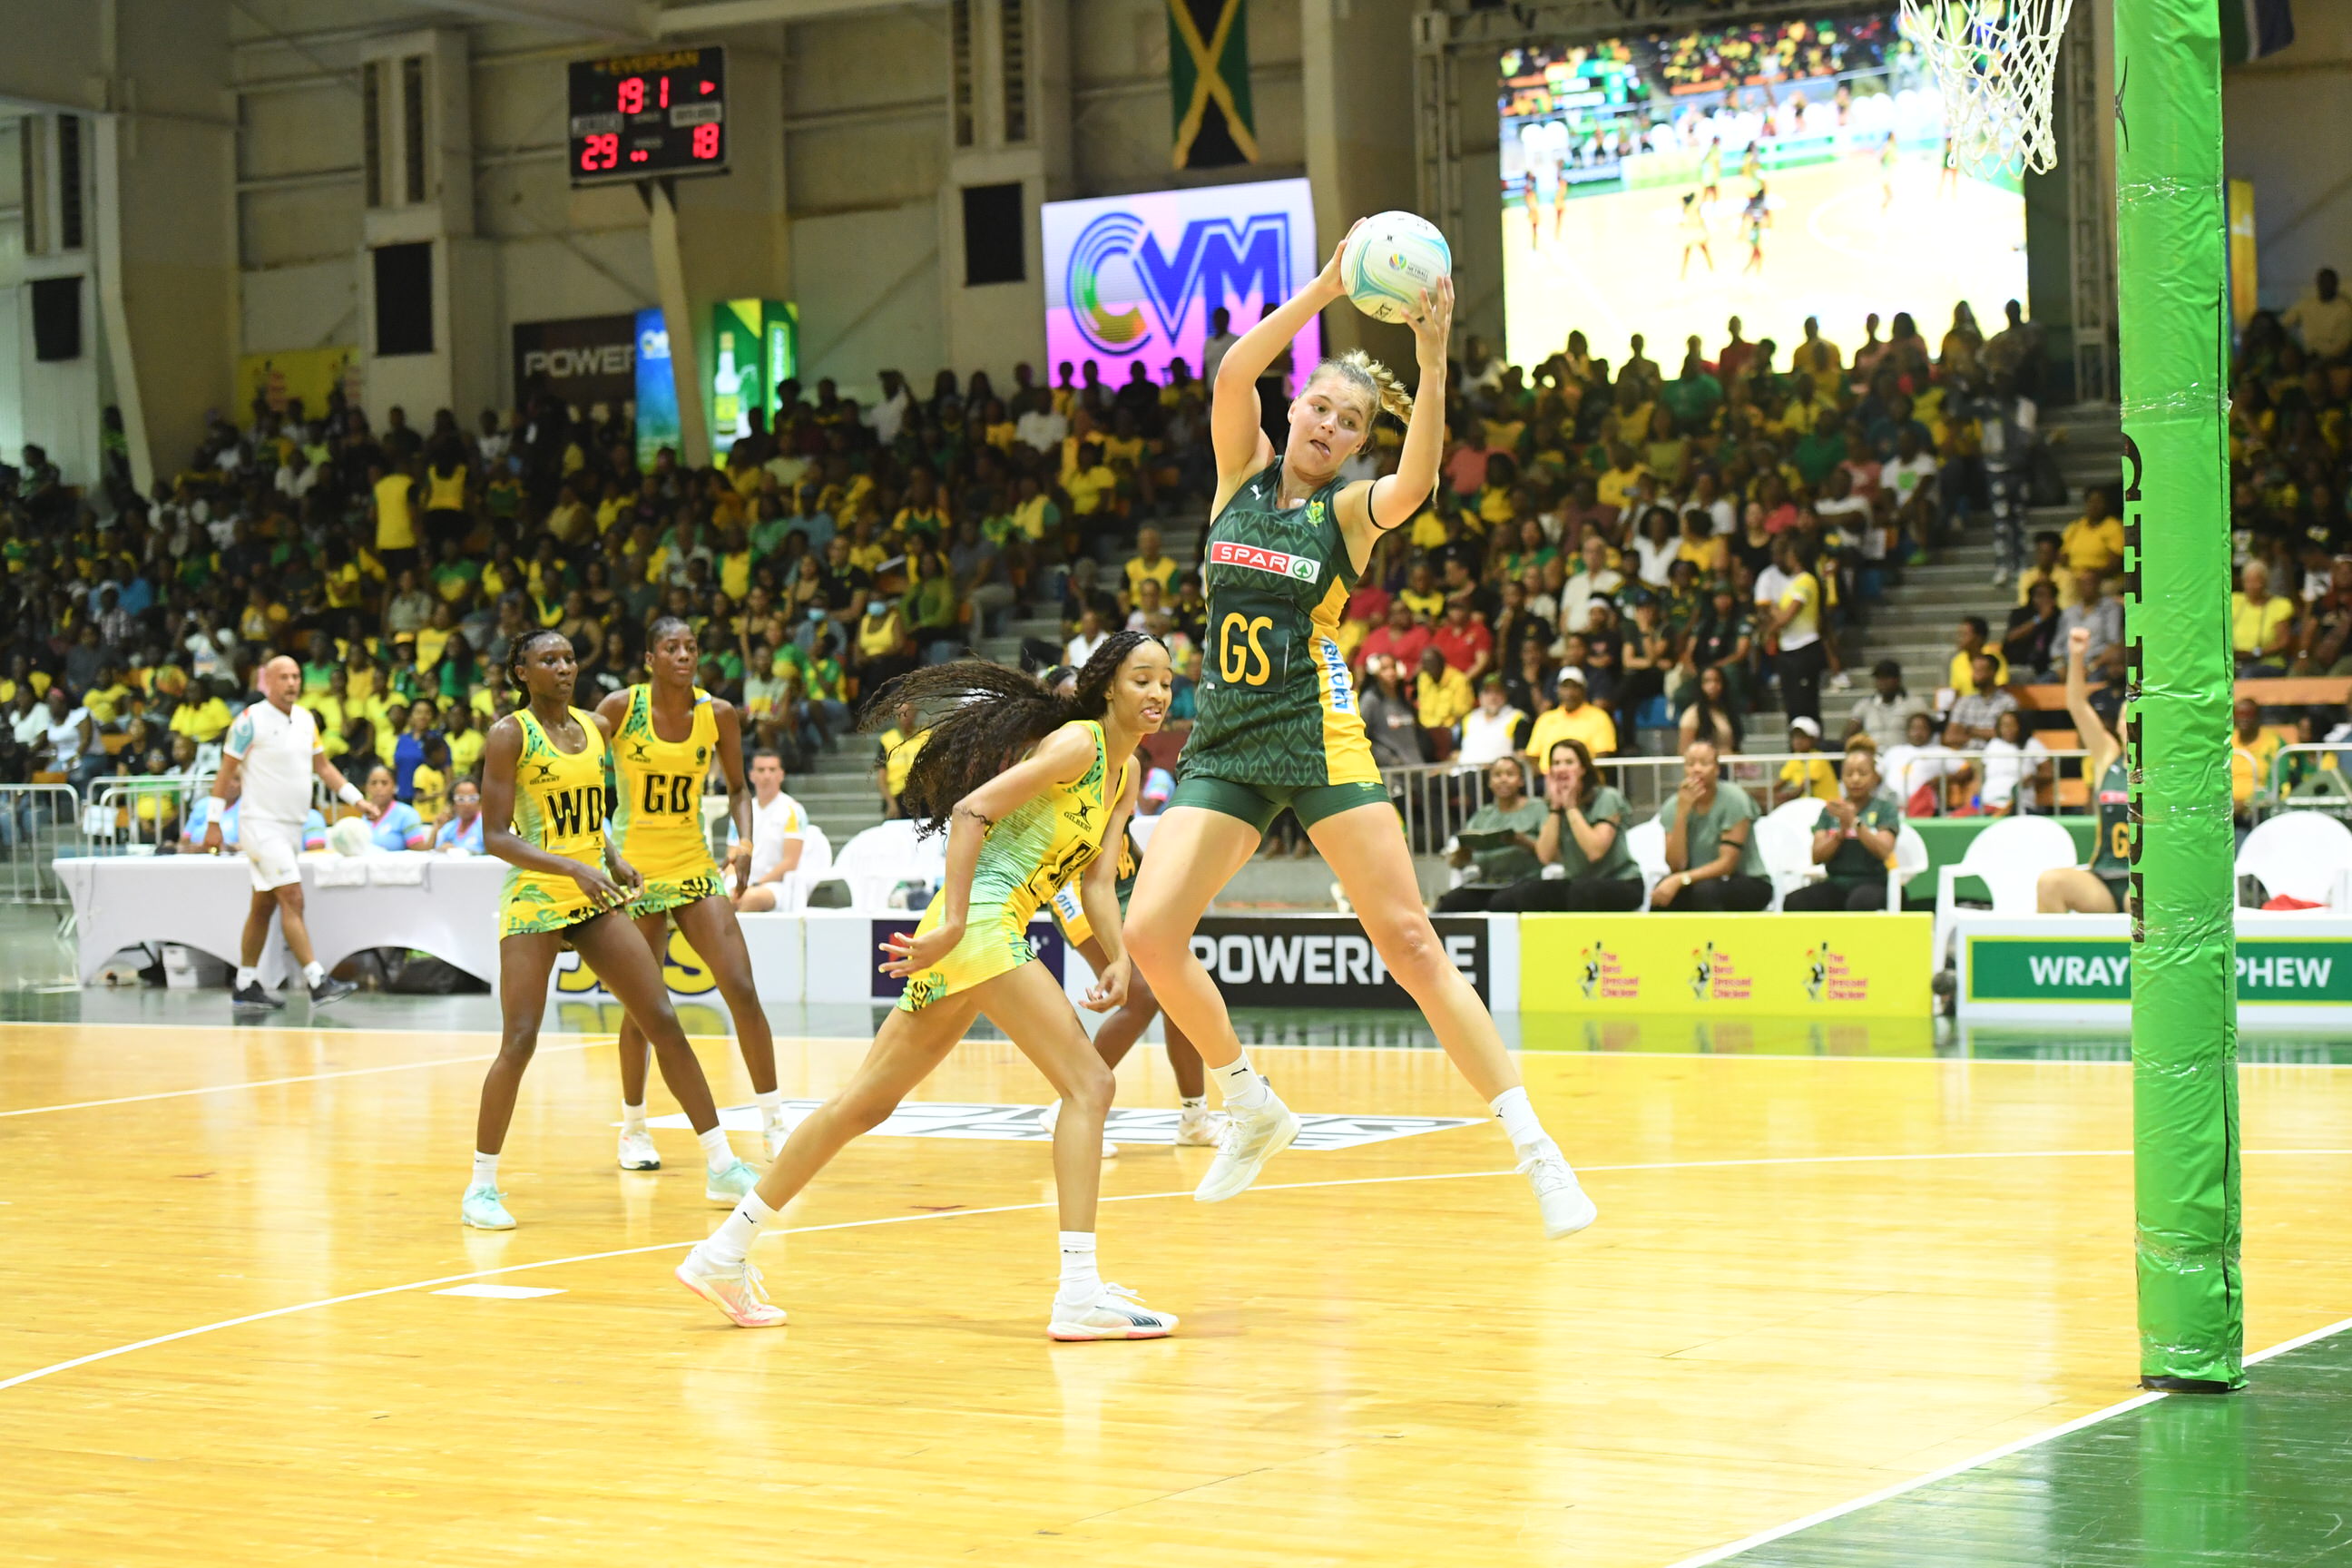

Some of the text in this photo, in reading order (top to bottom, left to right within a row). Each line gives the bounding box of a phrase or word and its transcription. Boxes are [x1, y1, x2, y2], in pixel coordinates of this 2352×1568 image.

[581, 132, 619, 171] 29
[692, 122, 720, 159] 18
[1066, 211, 1292, 356] CVM
[1220, 545, 1287, 573] SPAR
[1219, 612, 1273, 687] GS
[546, 787, 603, 837] WD
[643, 774, 693, 814] GD
[1063, 812, 1093, 833] GILBERT
[2112, 821, 2129, 858] G
[1190, 934, 1477, 985] POWERE
[1602, 952, 1617, 962] The
[1714, 953, 1729, 962] The
[1828, 954, 1844, 963] The
[2029, 956, 2332, 987] WRAY PHEW
